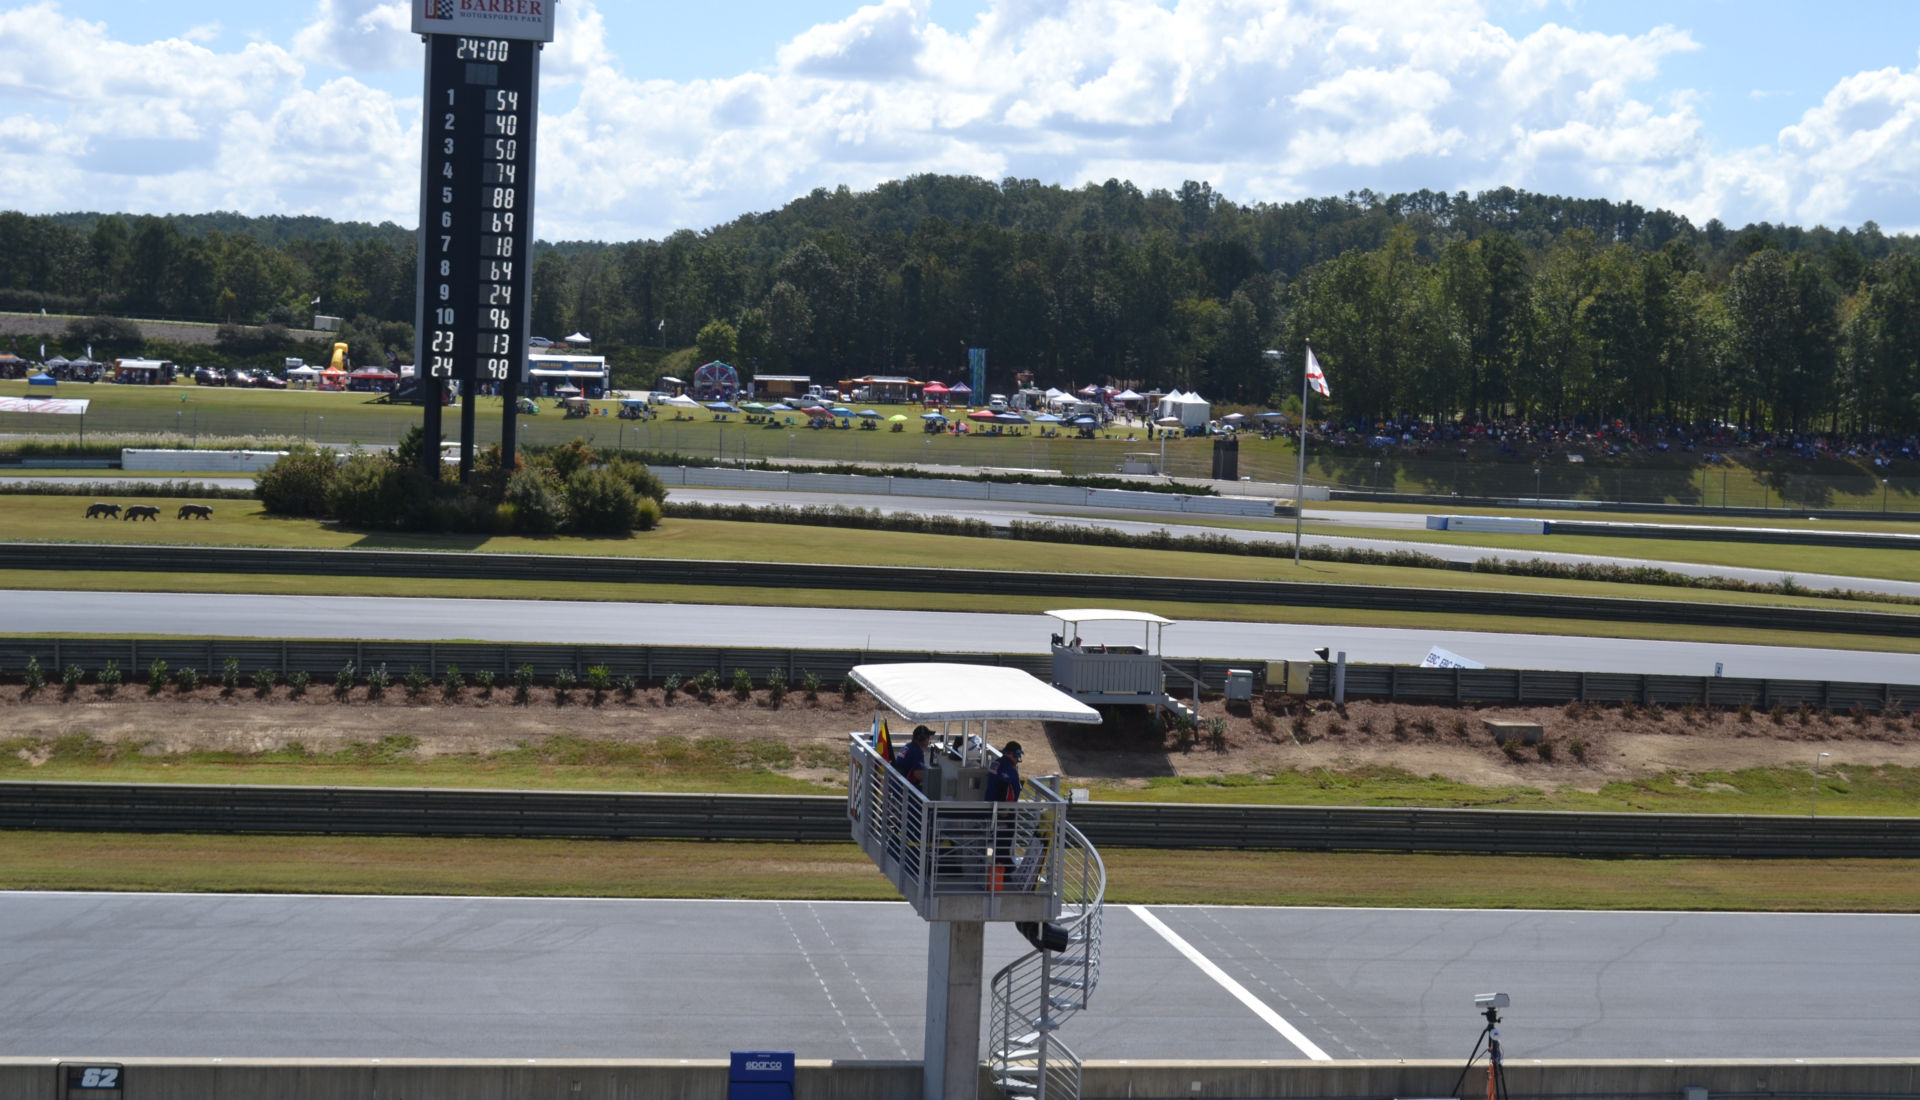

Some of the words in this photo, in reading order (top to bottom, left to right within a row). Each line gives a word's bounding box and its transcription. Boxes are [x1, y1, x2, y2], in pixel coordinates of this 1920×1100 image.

[459, 11, 518, 21] MOTORSPORTS
[460, 0, 542, 16] BARBER
[457, 38, 509, 62] 24:00
[447, 88, 455, 106] 1
[497, 90, 518, 111] 54
[444, 113, 455, 130] 2
[496, 115, 517, 136] 40
[443, 137, 454, 155] 3
[495, 139, 517, 160] 50
[442, 162, 453, 179] 4
[496, 162, 516, 184] 74
[442, 186, 452, 204] 5
[492, 187, 515, 209] 88
[441, 211, 452, 228] 6
[492, 212, 514, 233] 69
[441, 235, 451, 252] 7
[496, 236, 513, 258] 18
[440, 259, 450, 276] 8
[490, 261, 512, 281] 64
[440, 284, 449, 300] 9
[490, 284, 512, 305] 24
[435, 308, 454, 325] 10
[490, 308, 510, 329] 96
[432, 331, 454, 352] 23
[493, 334, 510, 355] 13
[431, 356, 453, 377] 24
[488, 358, 509, 380] 98
[745, 1061, 782, 1071] sparco
[81, 1068, 119, 1087] 62
